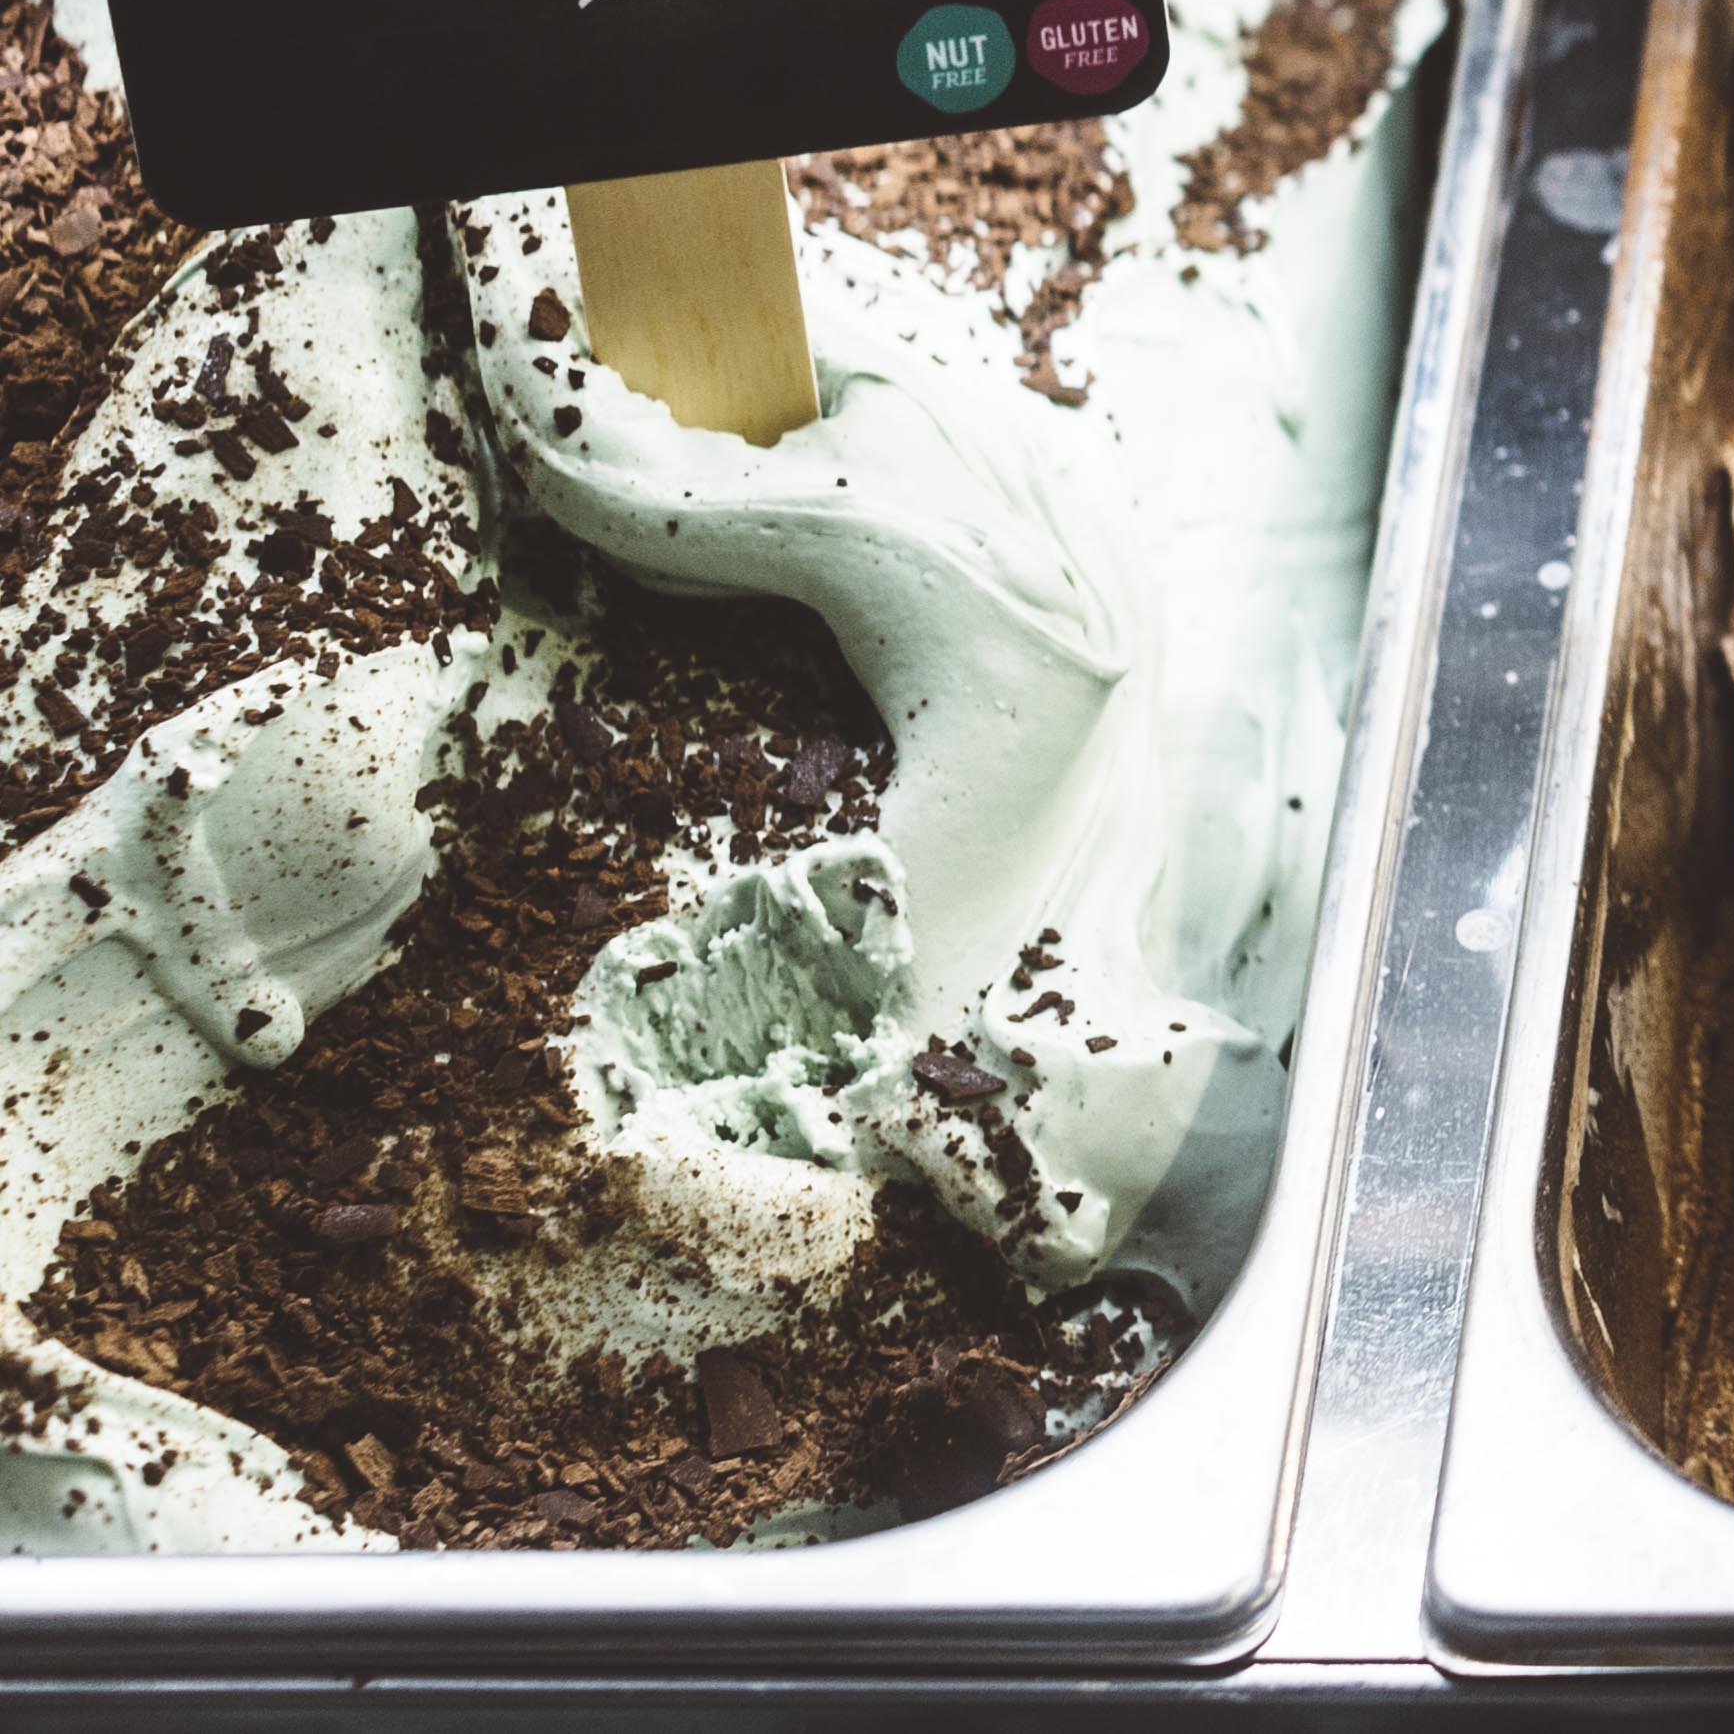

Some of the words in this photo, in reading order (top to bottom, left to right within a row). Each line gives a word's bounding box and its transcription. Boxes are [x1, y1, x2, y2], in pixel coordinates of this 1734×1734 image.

[1040, 15, 1139, 51] GLUTEN
[926, 35, 988, 71] NUT
[1064, 46, 1119, 69] FREE
[931, 67, 988, 90] FREE
